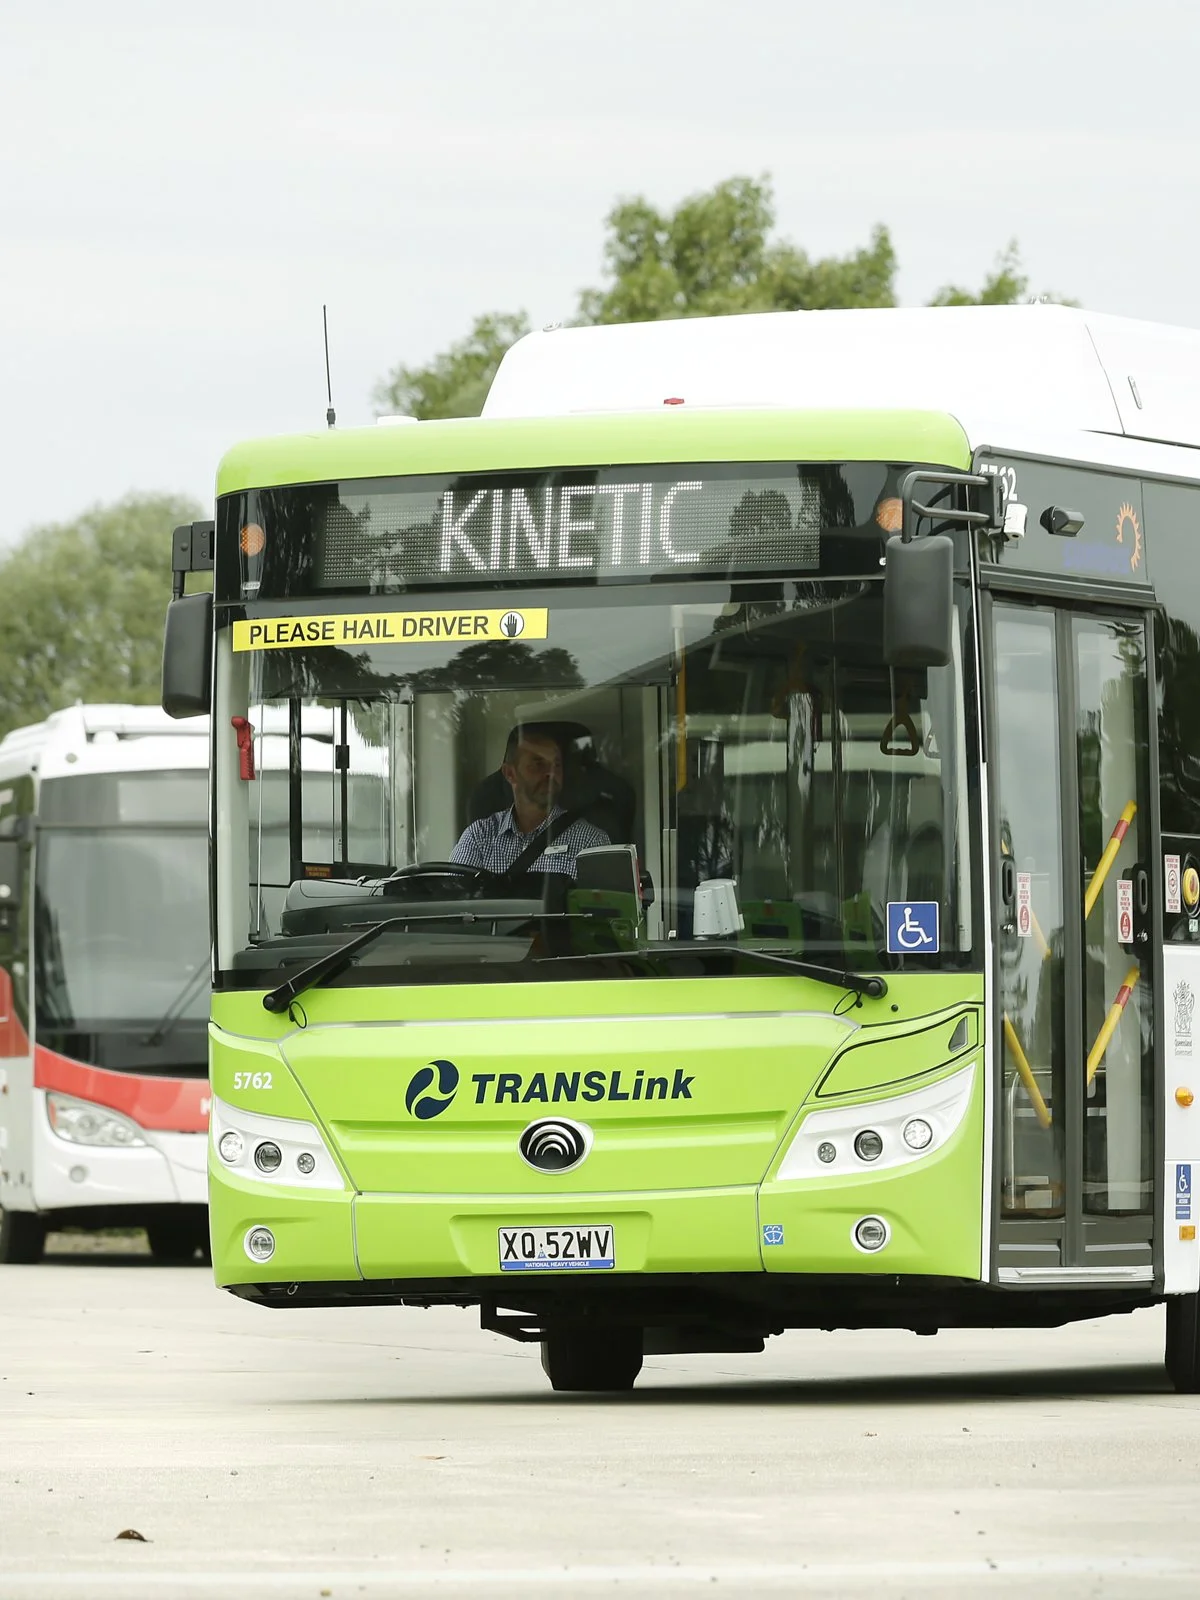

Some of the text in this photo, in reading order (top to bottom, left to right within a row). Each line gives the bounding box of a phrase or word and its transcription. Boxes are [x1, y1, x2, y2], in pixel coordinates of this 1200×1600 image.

[440, 480, 703, 573] KINETIC
[250, 615, 489, 645] PLEASE HAIL DRIVER
[233, 1071, 273, 1090] 5762
[471, 1068, 697, 1104] TRANSLink
